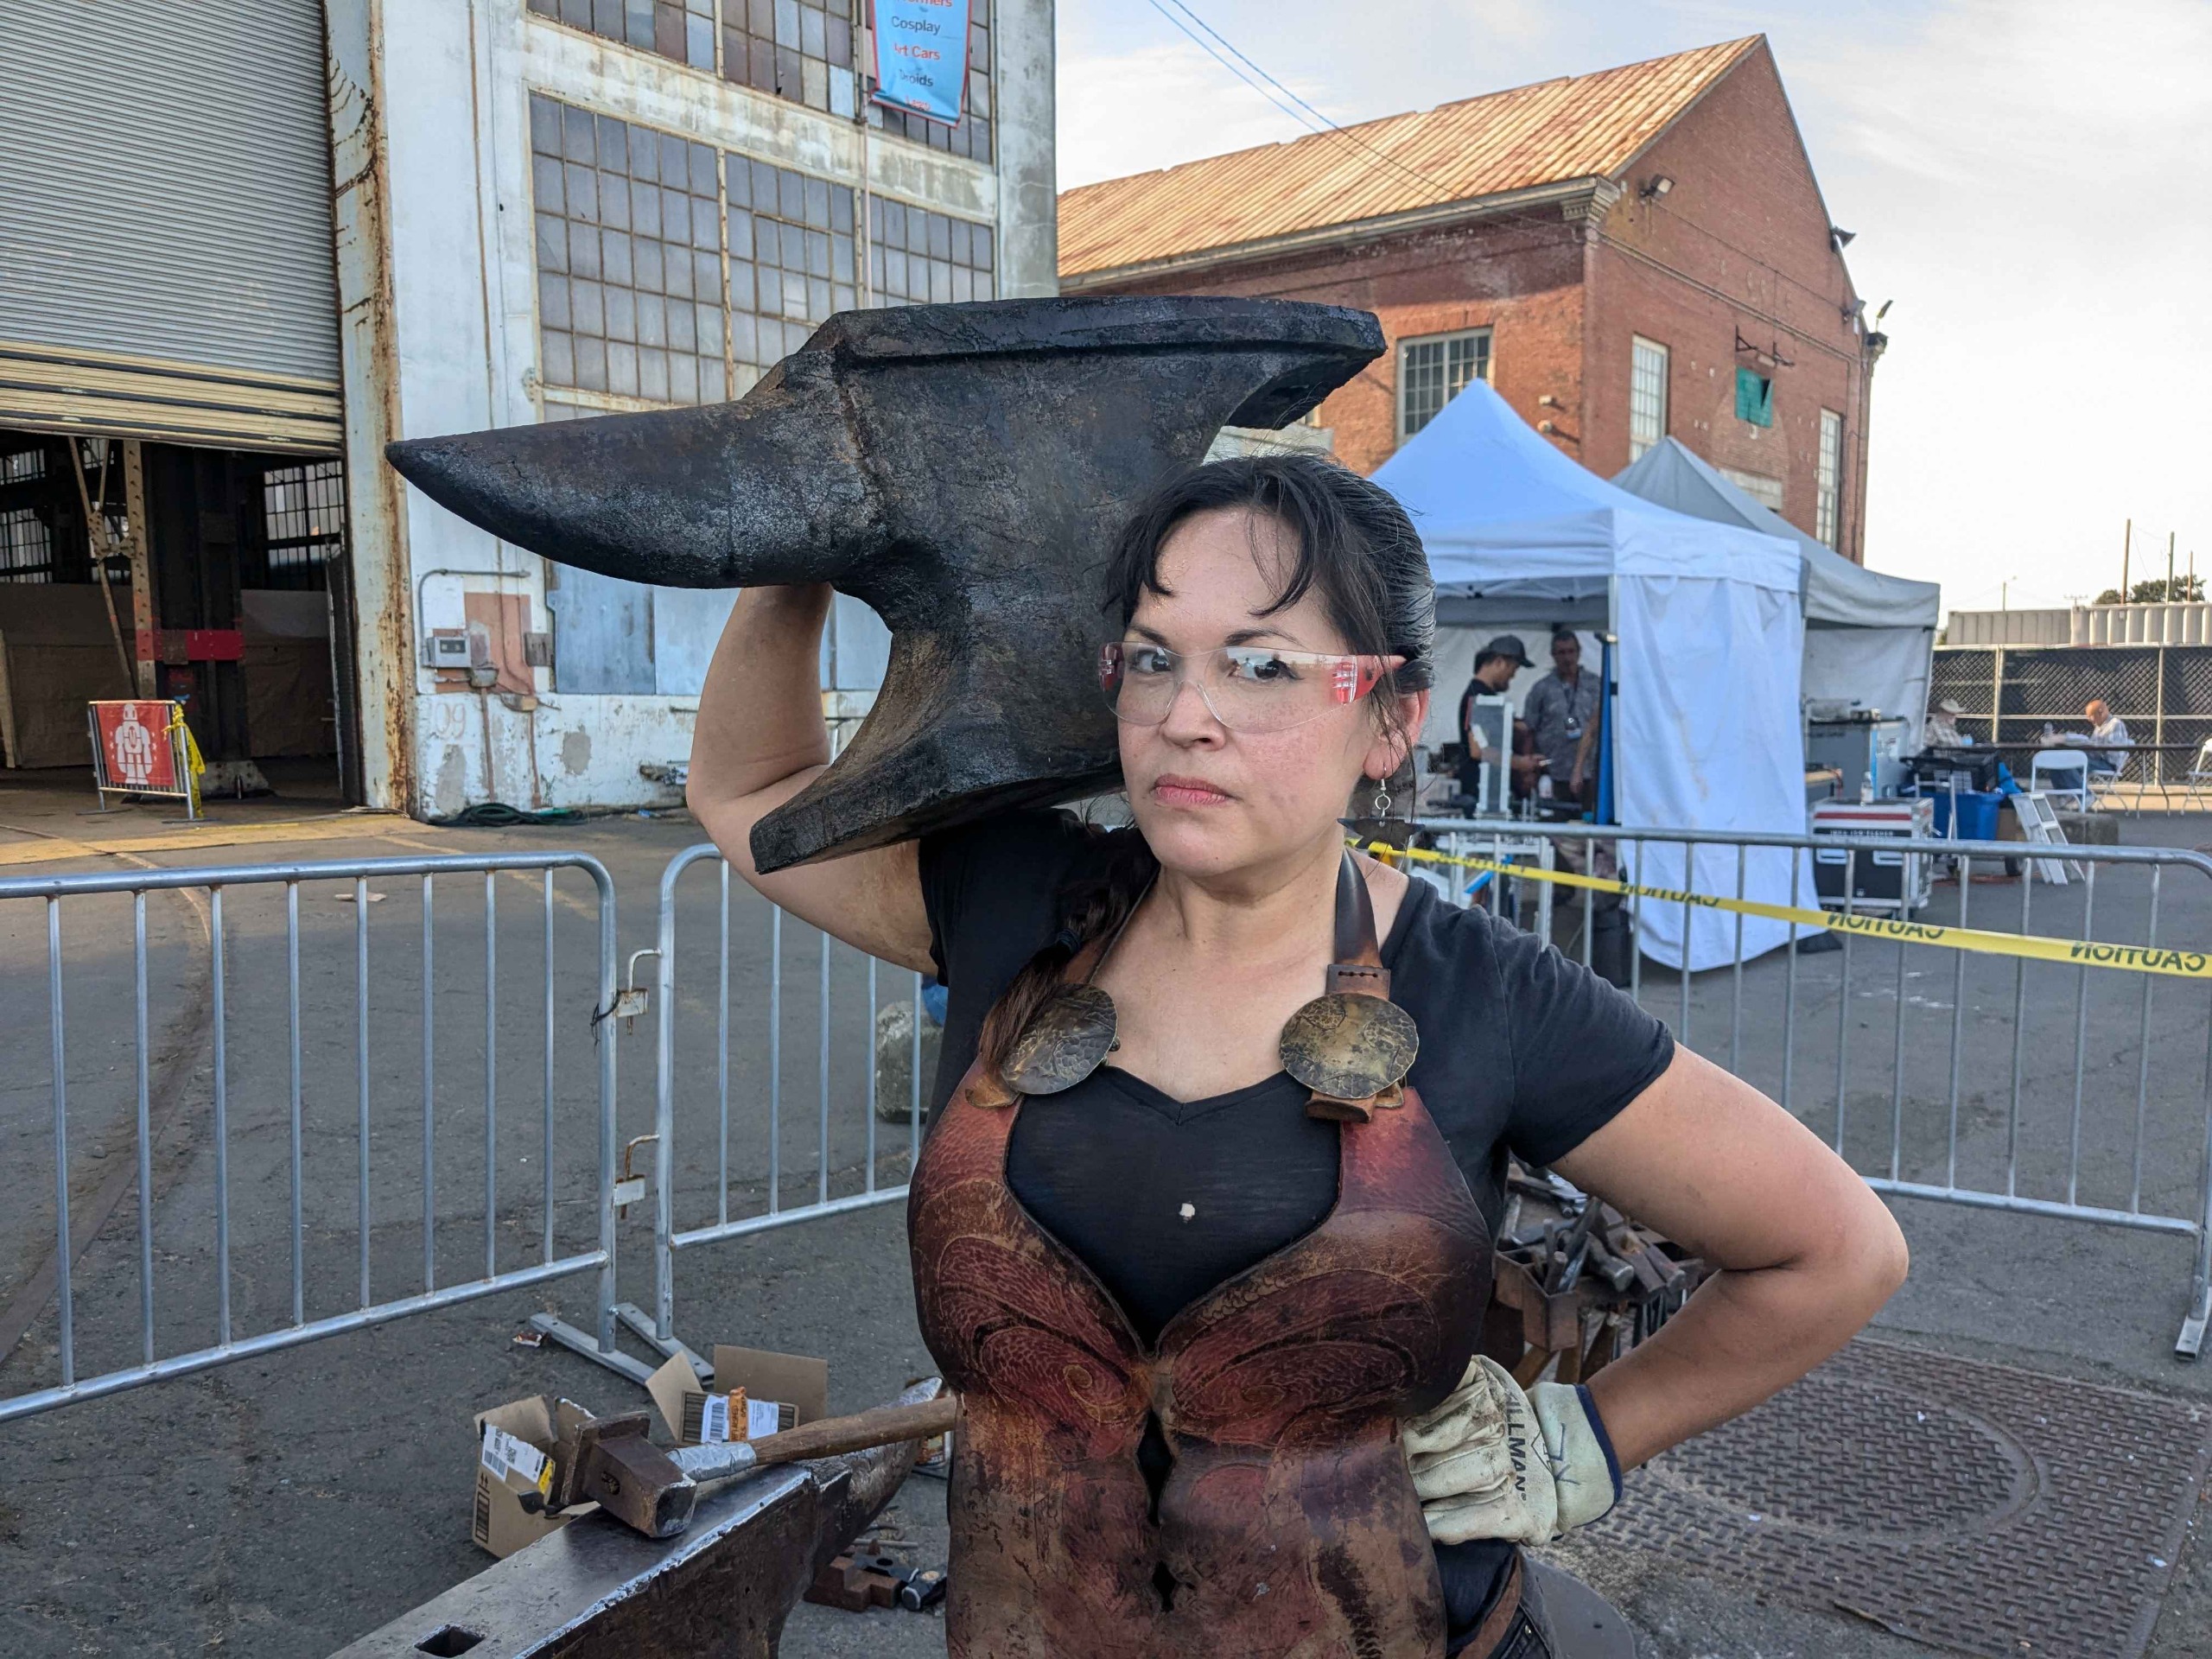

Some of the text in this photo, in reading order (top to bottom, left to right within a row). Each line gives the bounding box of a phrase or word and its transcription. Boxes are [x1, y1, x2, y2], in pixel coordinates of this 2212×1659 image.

[891, 16, 941, 35] Cosplay
[912, 46, 940, 60] Cars
[1505, 1392, 1526, 1492] ILLMAN
